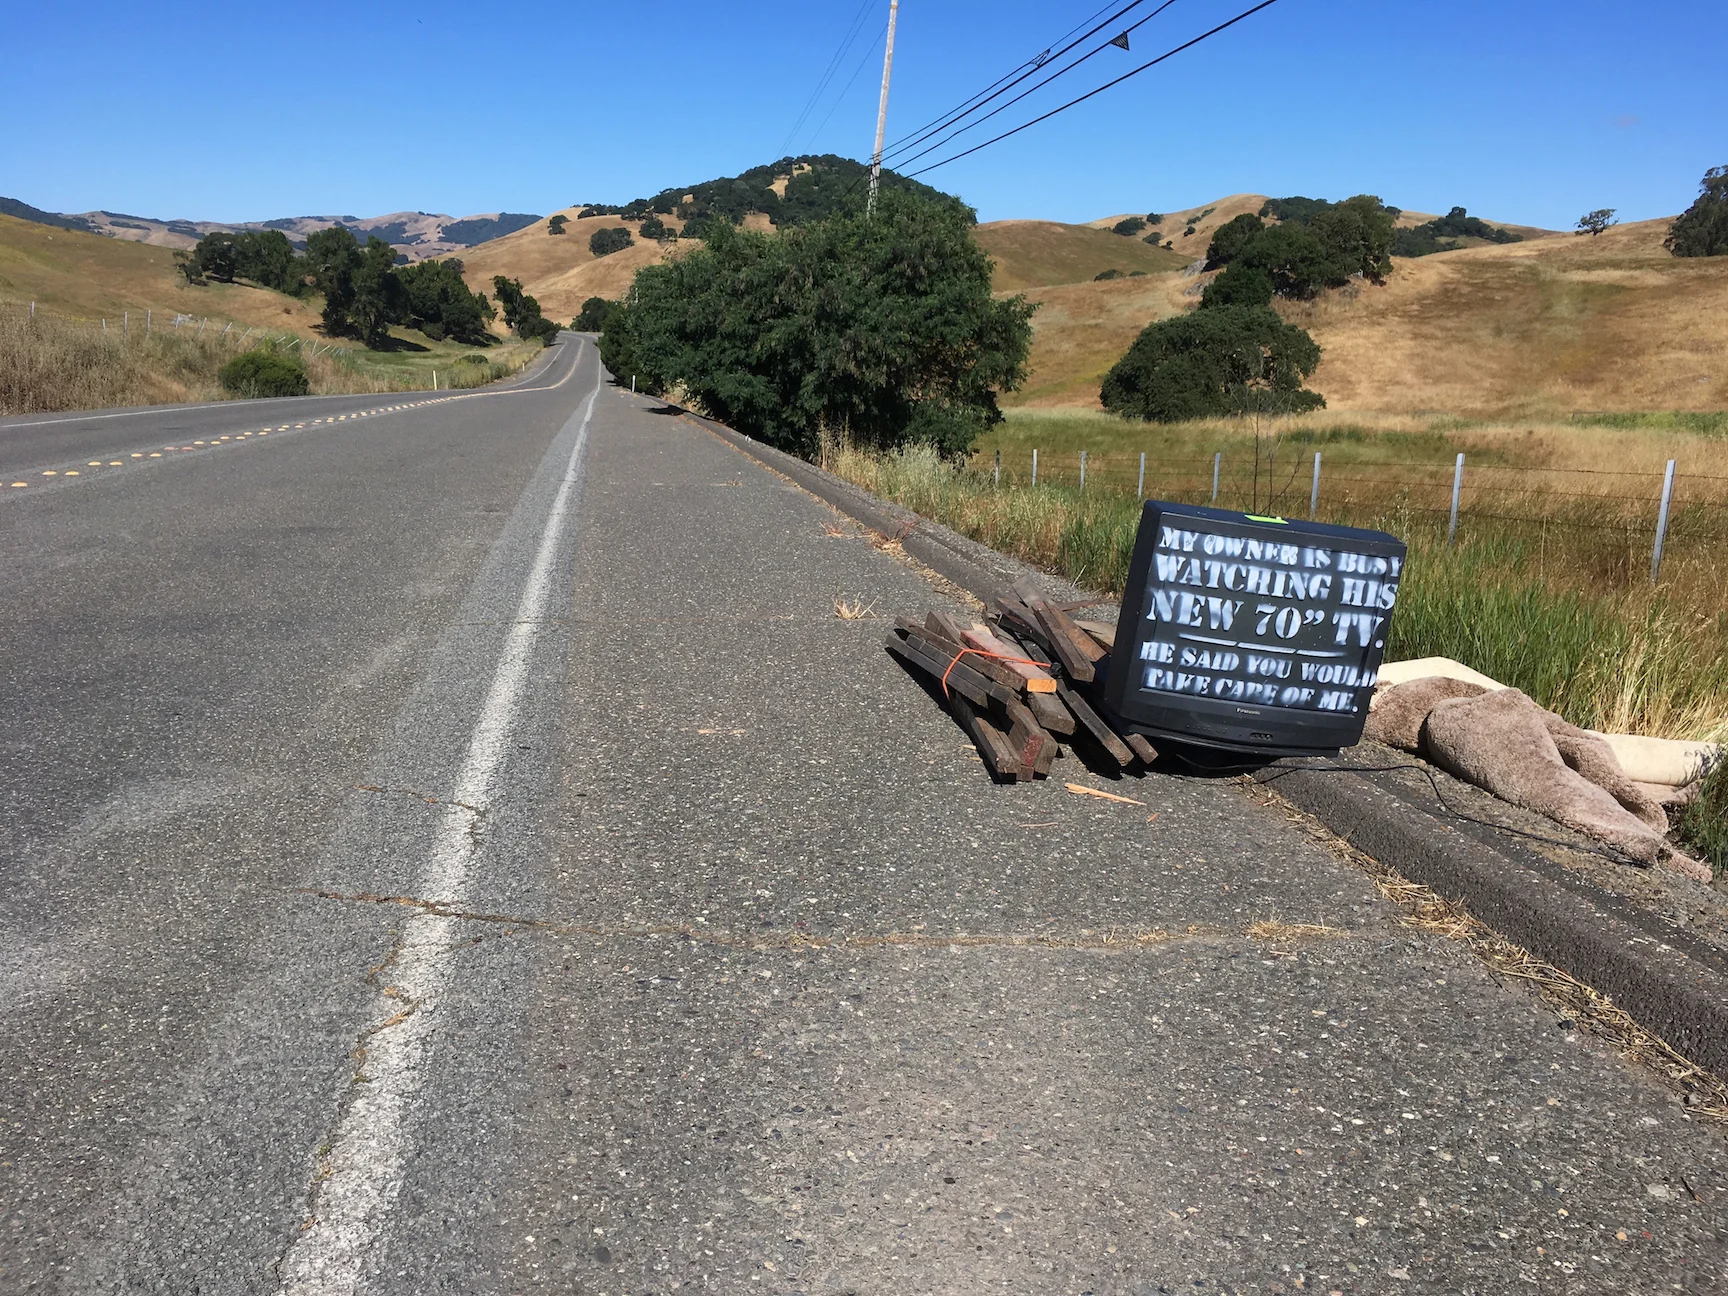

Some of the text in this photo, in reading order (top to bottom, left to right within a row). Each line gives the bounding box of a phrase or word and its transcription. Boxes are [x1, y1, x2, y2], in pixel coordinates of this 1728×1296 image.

[1160, 526, 1402, 577] MY OWNER IS BUSY
[1156, 553, 1400, 610] WATCHING HIS
[1147, 589, 1244, 631] NEW
[1332, 611, 1385, 649] TV.
[1140, 641, 1377, 688] HE SAID YOU WOULD
[1146, 667, 1359, 712] TAKE CARE OF ME.
